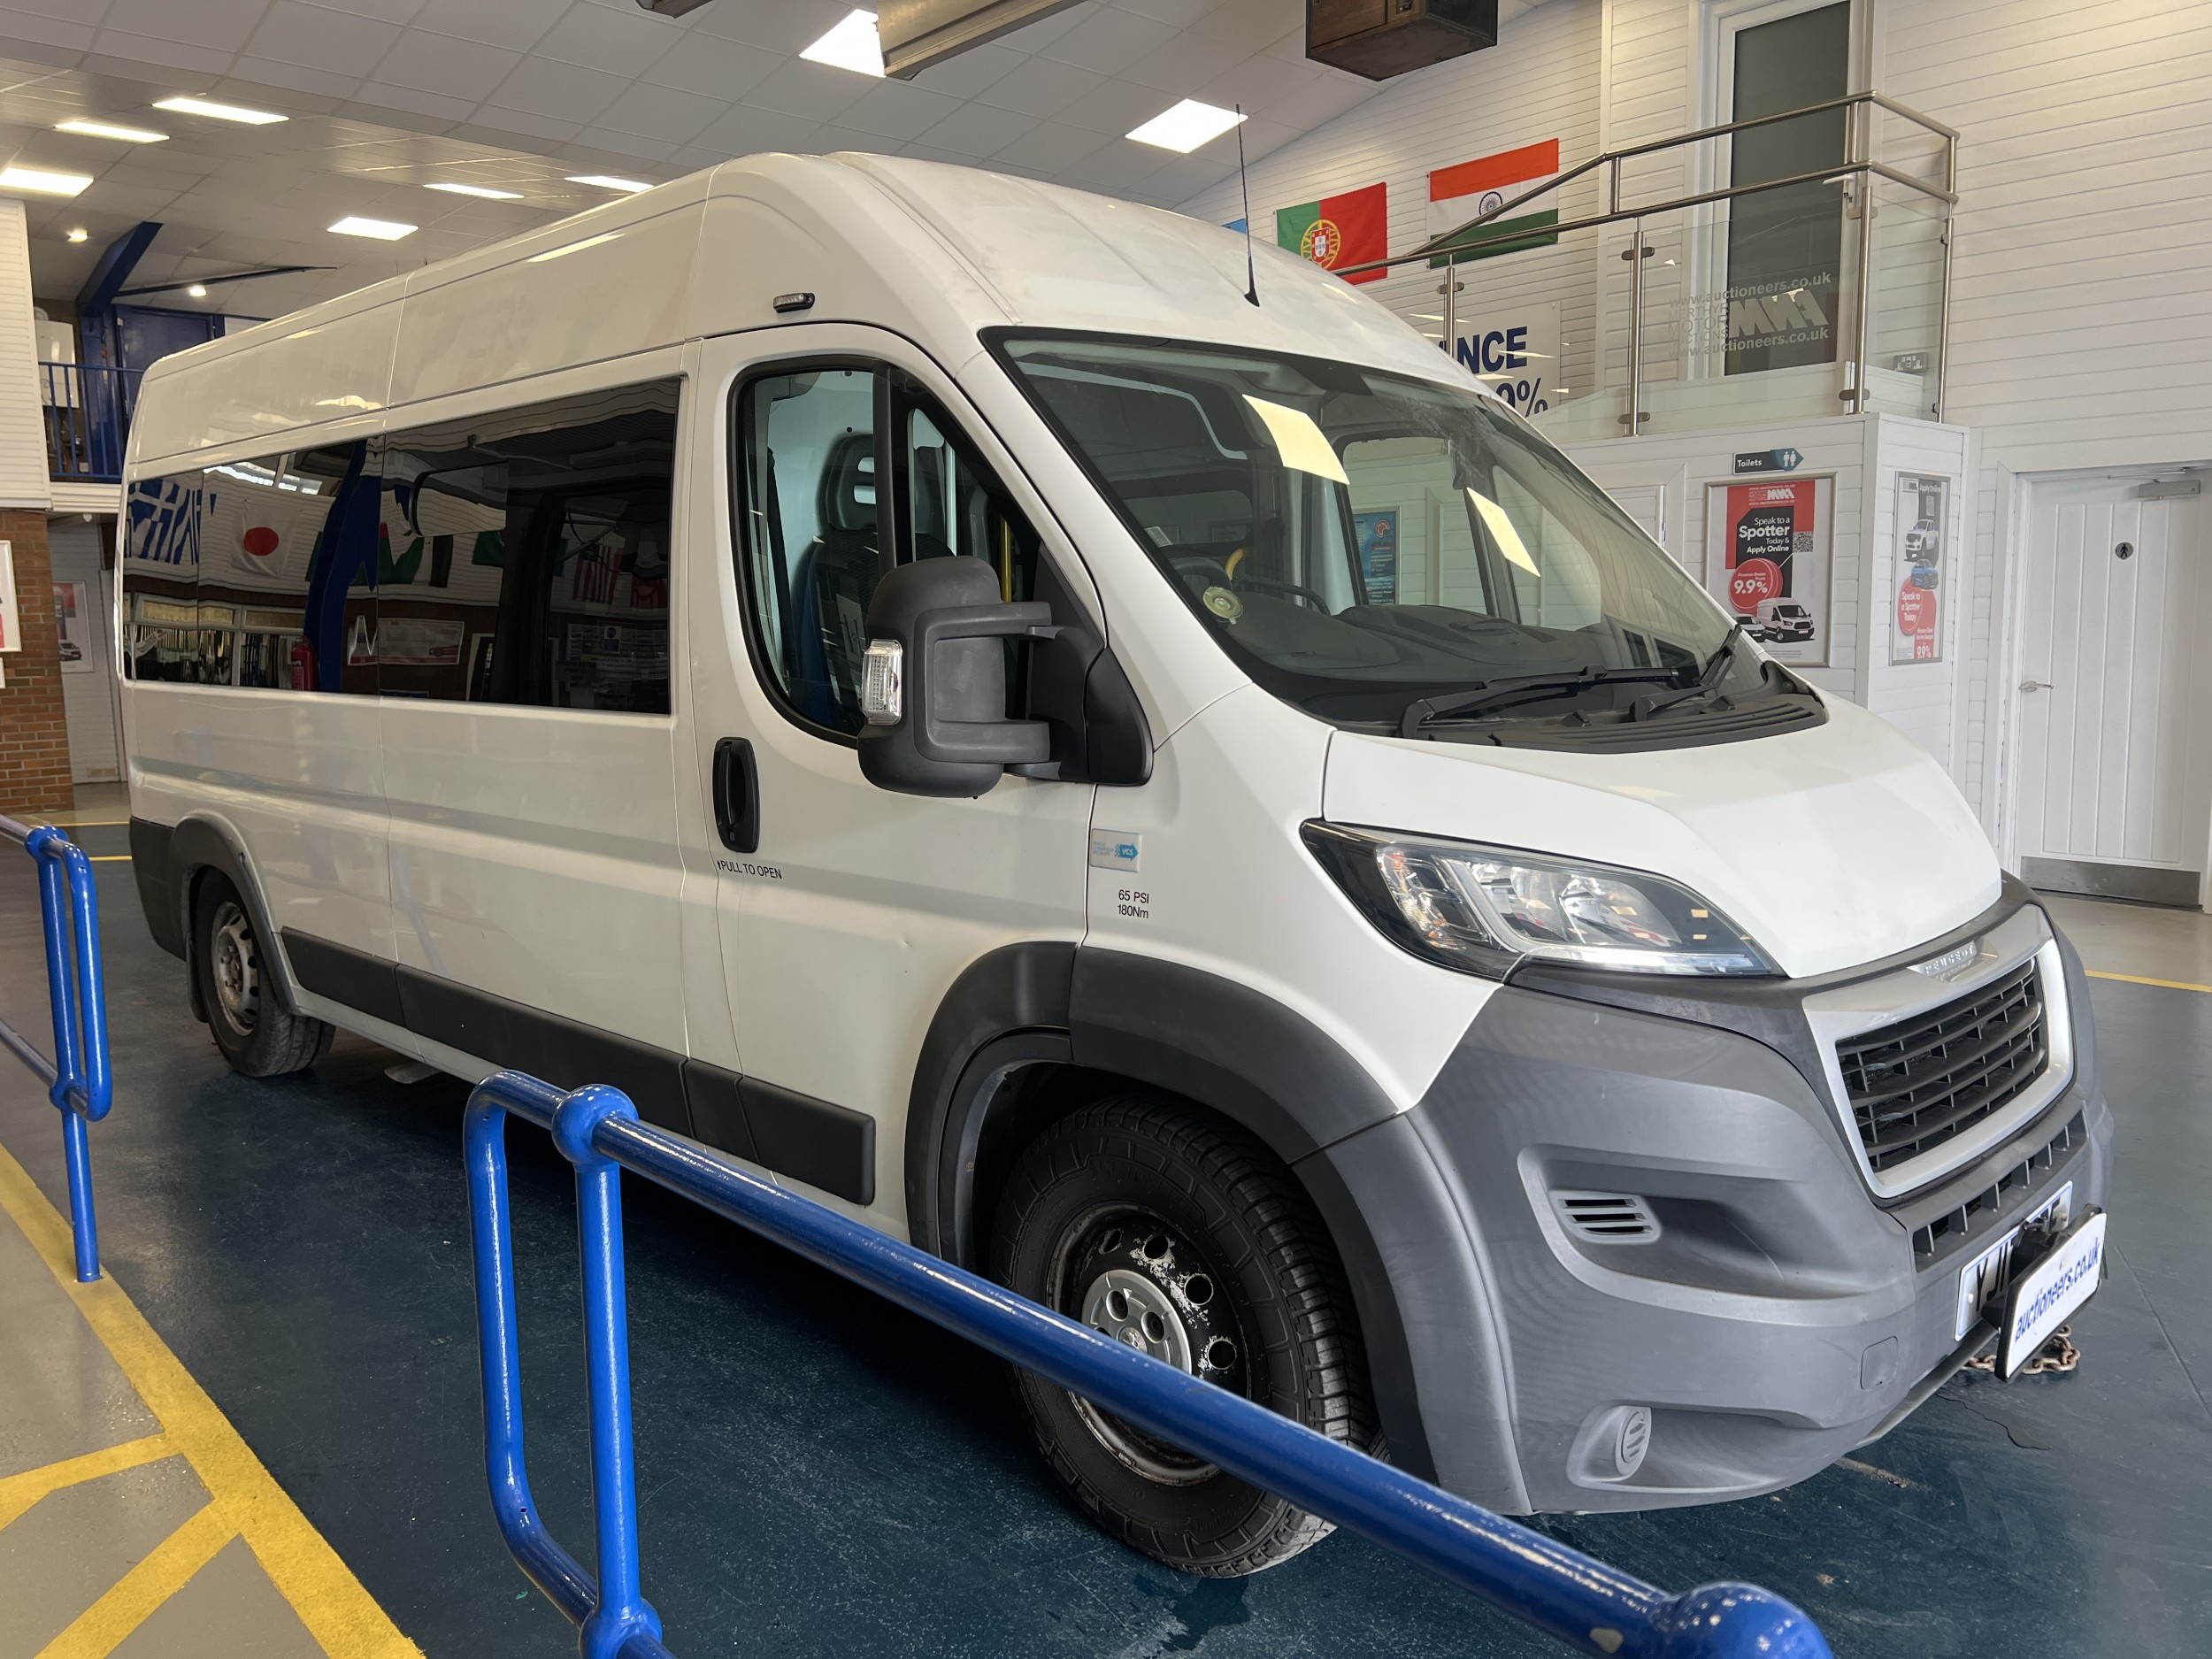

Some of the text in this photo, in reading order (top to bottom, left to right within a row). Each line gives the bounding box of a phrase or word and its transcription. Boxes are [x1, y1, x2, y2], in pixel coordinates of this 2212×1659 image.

[1670, 272, 1831, 308] www.auctioneers.co.uk
[1669, 303, 1728, 321] MERTHYR
[1669, 315, 1728, 334] MOTOR
[1439, 326, 1527, 374] NCE
[1670, 327, 1829, 357] www.auctioneers.co.uk
[1755, 517, 1776, 526] Speak
[1739, 525, 1790, 541] Spotter
[1733, 579, 1768, 594] 9.9%
[1121, 848, 1133, 856] VCS
[720, 859, 782, 879] PULL TO OPEN
[1118, 889, 1149, 904] 65 PSI
[1118, 904, 1149, 918] 180Nm
[2015, 1236, 2101, 1342] auctioneers.co.uk
